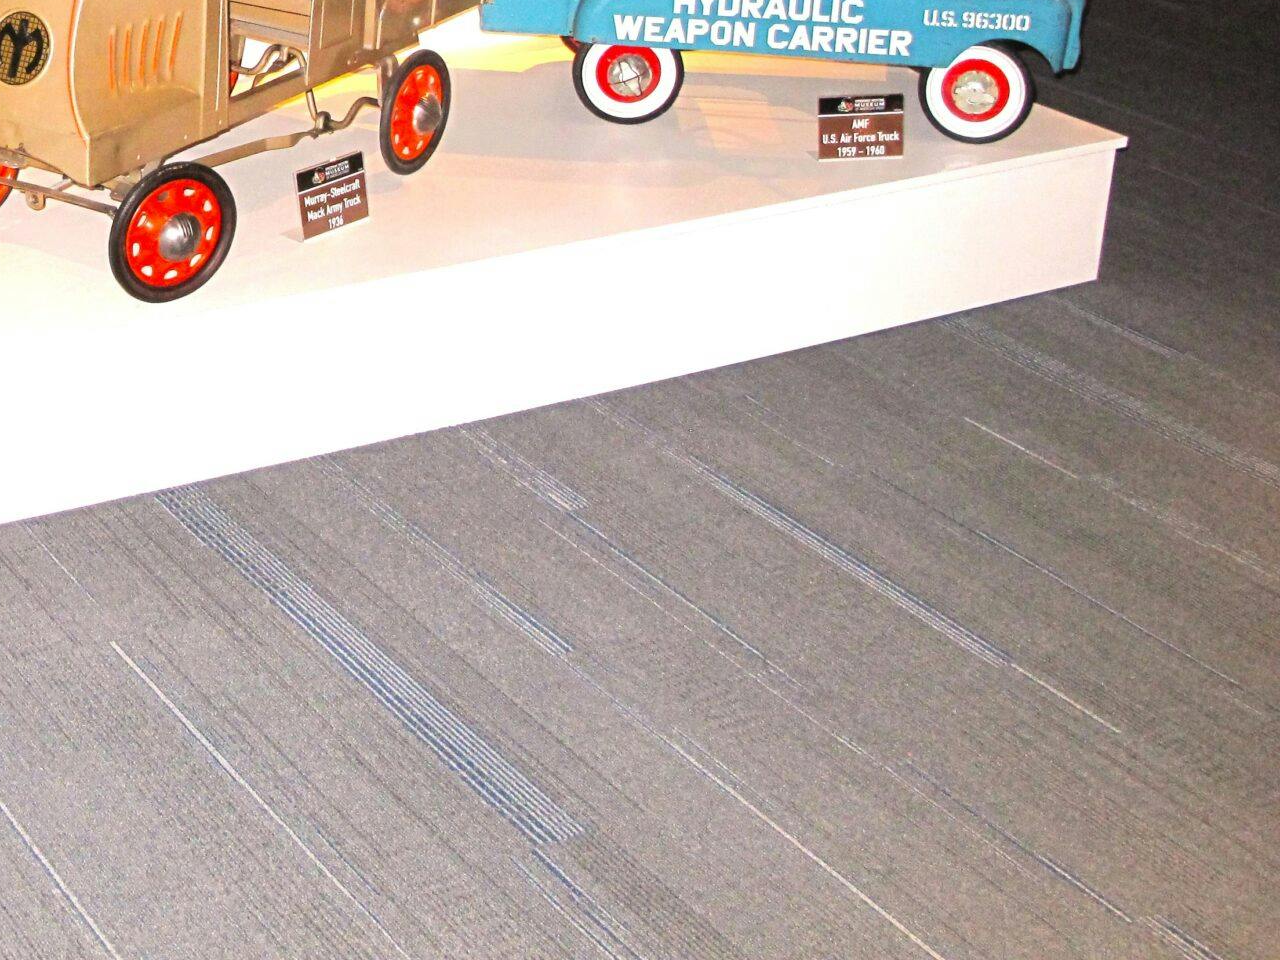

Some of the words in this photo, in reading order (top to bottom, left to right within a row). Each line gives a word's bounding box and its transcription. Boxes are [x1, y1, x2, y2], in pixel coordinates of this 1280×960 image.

[923, 9, 957, 28] U.S.
[961, 11, 1031, 31] 96300
[613, 14, 755, 48] WEAPON
[767, 23, 913, 56] CARRIER
[852, 119, 869, 129] AMF
[822, 134, 838, 144] U.S.
[840, 133, 852, 143] Air
[854, 133, 875, 142] Force
[878, 131, 899, 141] Truck
[838, 147, 856, 157] 1959
[866, 145, 885, 155] 1960
[304, 179, 360, 207] Murray-Steelcraft
[307, 207, 325, 221] Mack
[327, 201, 342, 215] Army
[344, 194, 361, 208] Truck
[329, 215, 344, 228] 1936
